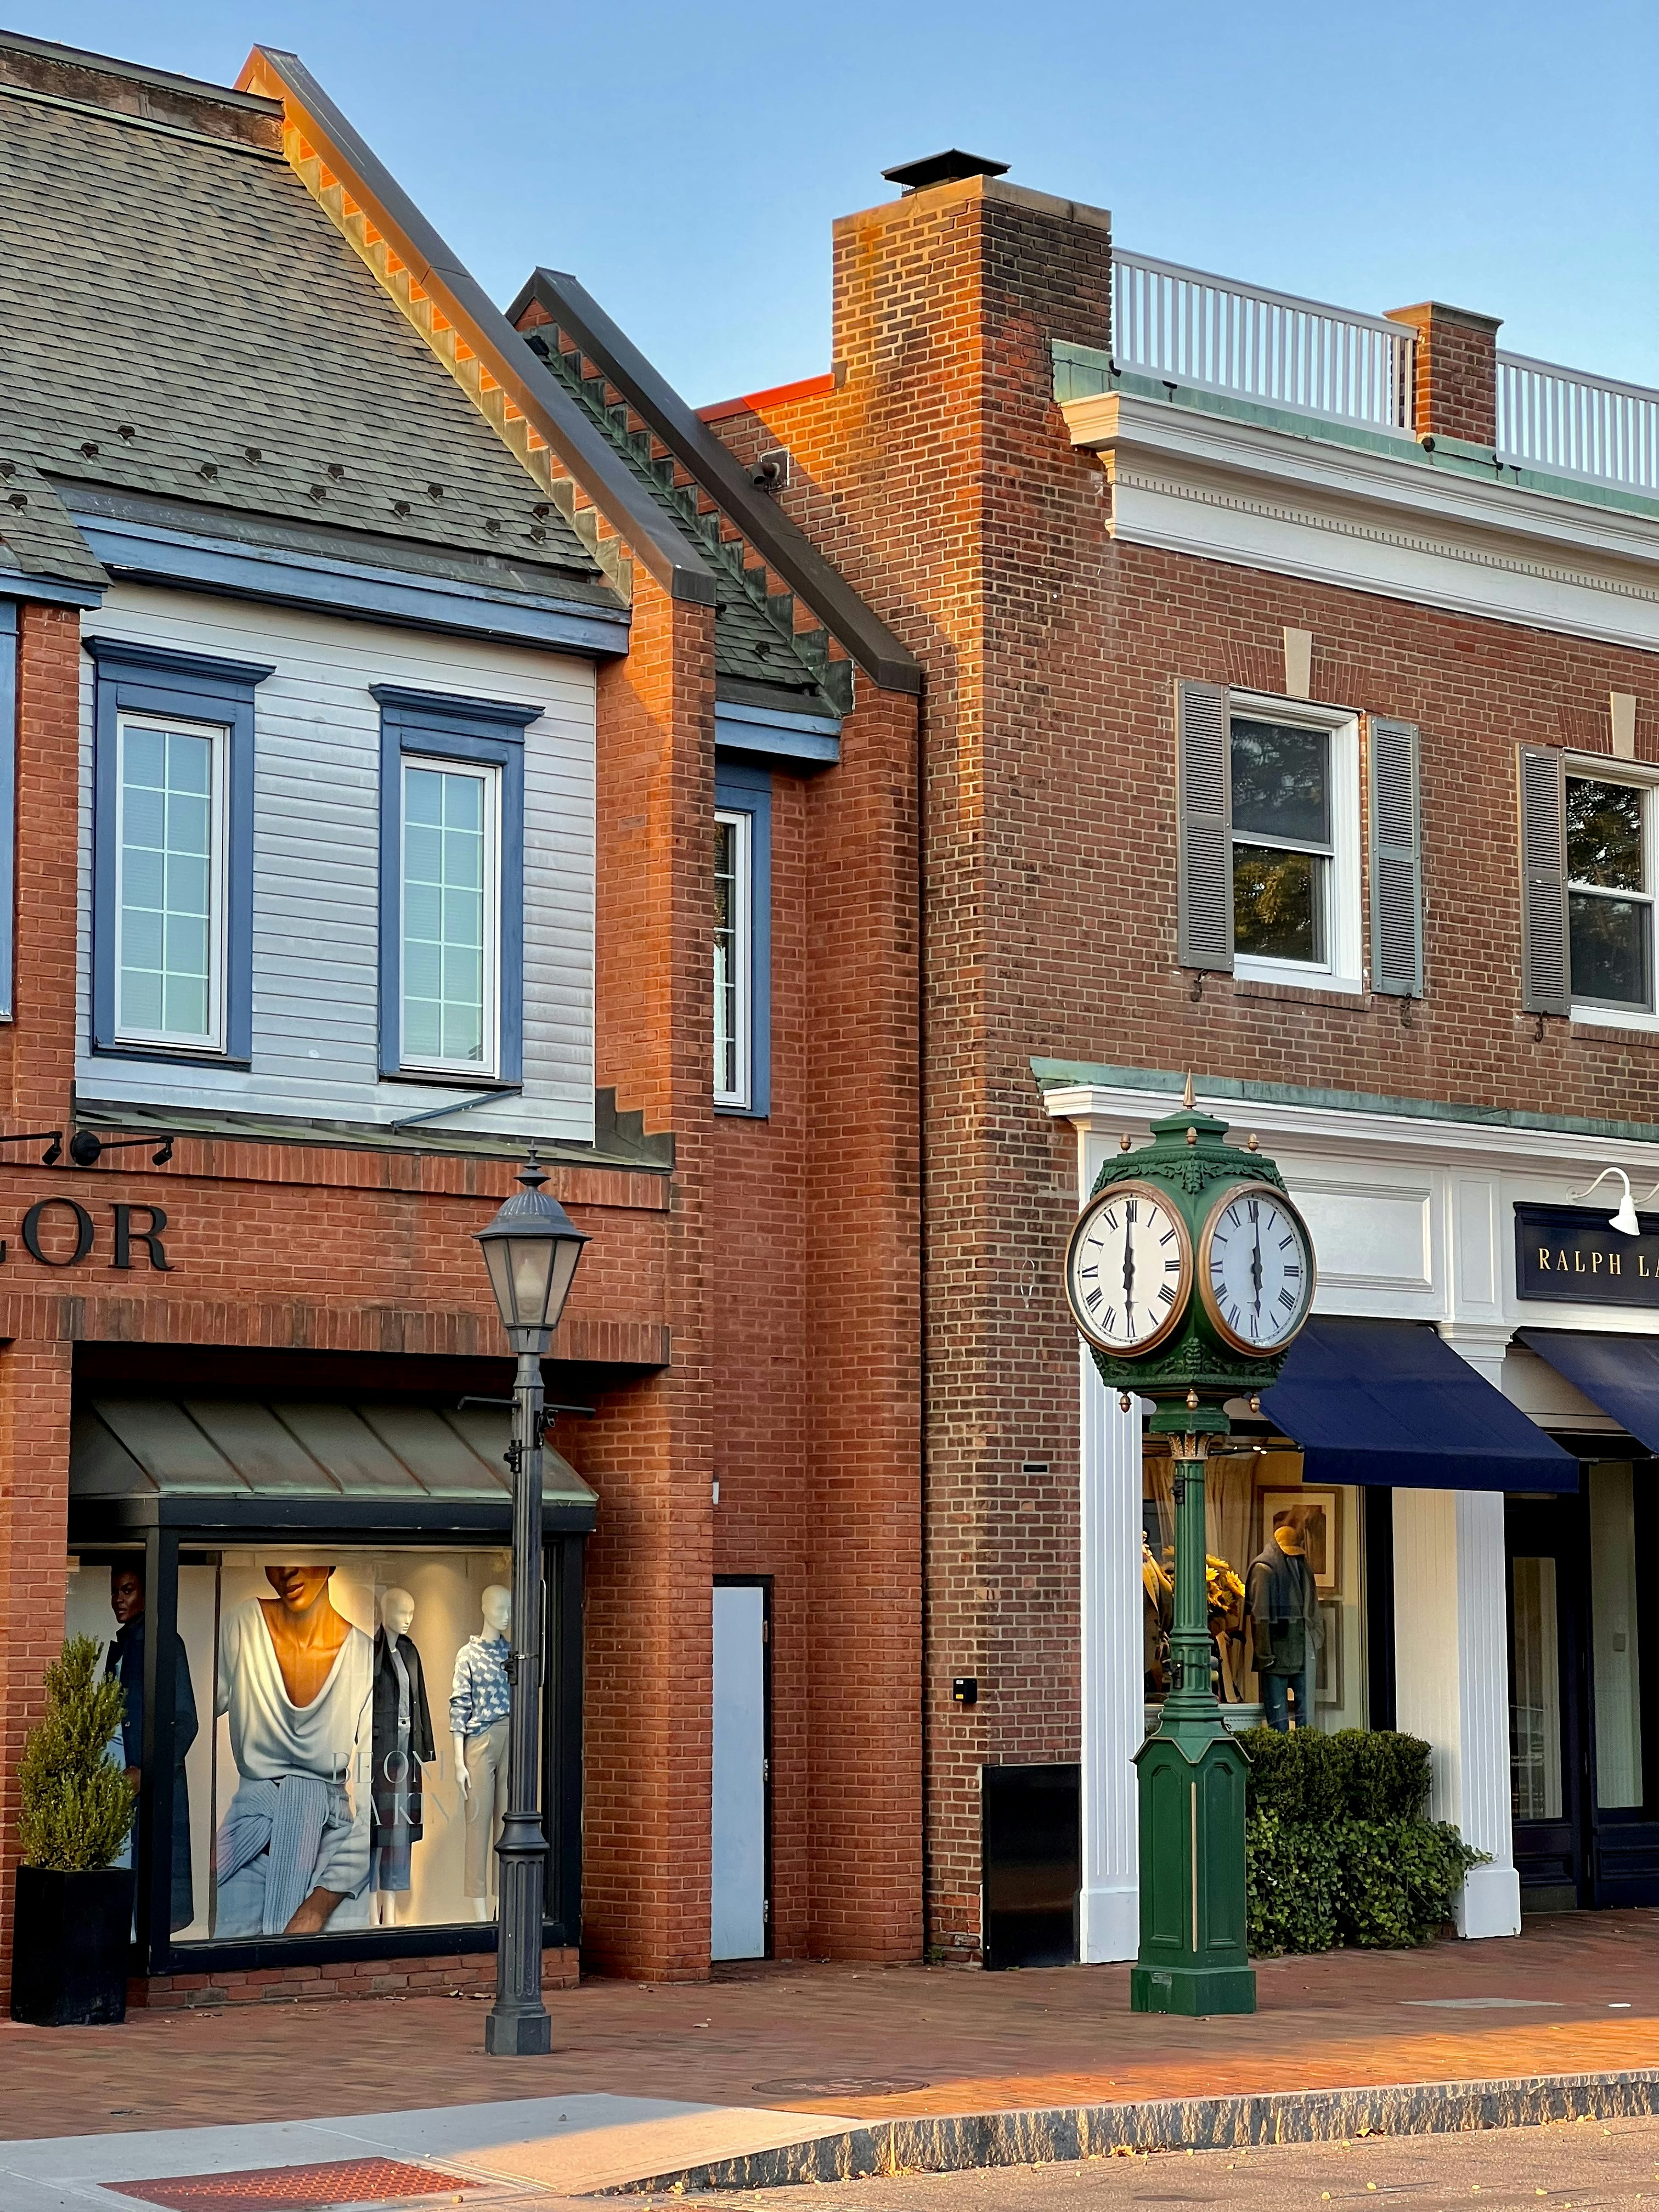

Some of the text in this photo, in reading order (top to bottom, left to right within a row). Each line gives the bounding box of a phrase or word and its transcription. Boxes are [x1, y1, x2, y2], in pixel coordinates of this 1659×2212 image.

[0, 1197, 175, 1271] OR
[1538, 1248, 1621, 1275] RALPH
[332, 1751, 374, 1784] BE
